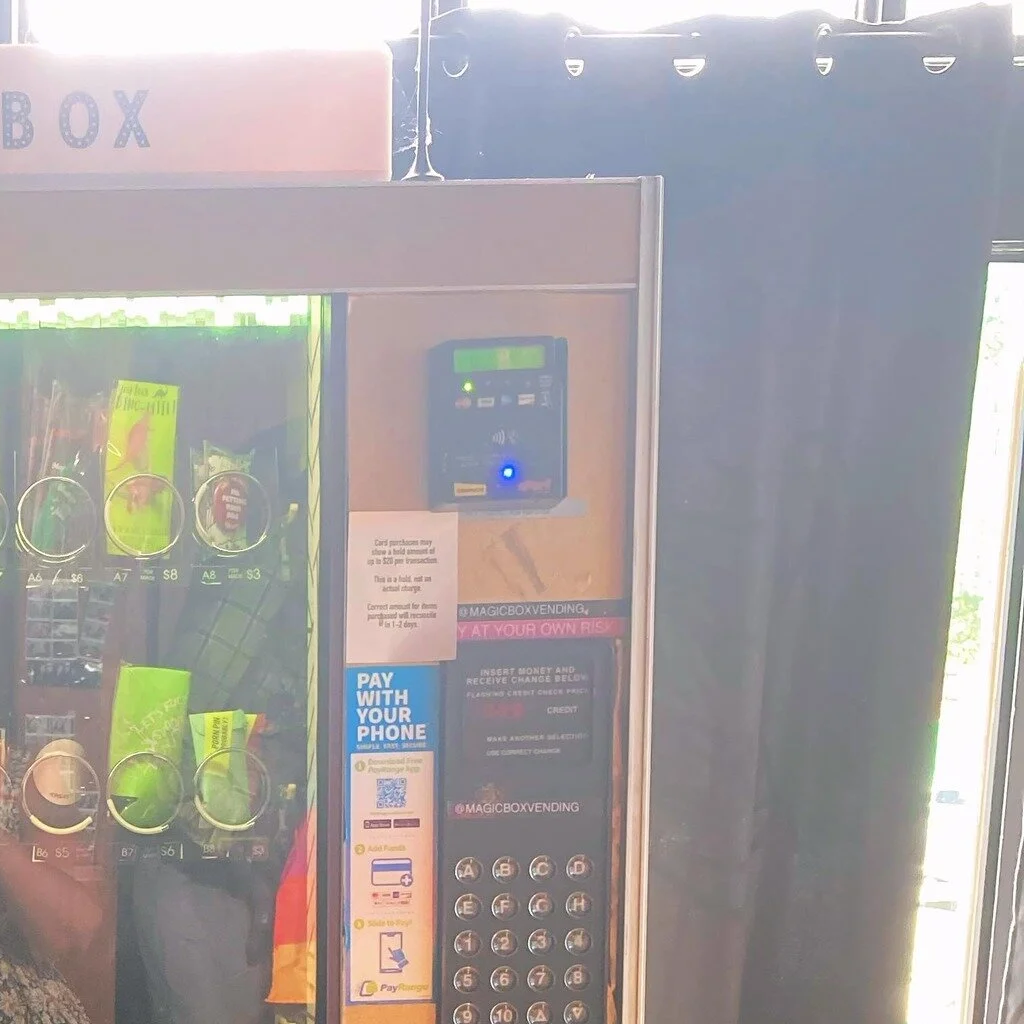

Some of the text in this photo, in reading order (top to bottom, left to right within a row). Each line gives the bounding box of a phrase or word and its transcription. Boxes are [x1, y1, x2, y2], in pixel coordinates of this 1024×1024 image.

[1, 89, 152, 150] BOX
[420, 539, 433, 548] may
[27, 573, 43, 584] A6
[112, 572, 129, 583] A7
[163, 569, 179, 581] $8
[201, 570, 217, 580] A8
[246, 569, 262, 580] $3
[367, 603, 389, 611] Correct
[411, 602, 420, 610] for
[458, 603, 586, 618] @MAGICBOXVENDING
[471, 623, 491, 637] AT
[494, 622, 536, 637] YOUR
[540, 621, 576, 636] OWN
[480, 665, 576, 677] INSERT MONEY AND
[357, 672, 394, 690] PAY
[466, 676, 508, 686] RECEIVE
[511, 675, 551, 684] CHANGE
[356, 688, 409, 707] WITH
[507, 688, 564, 697] CREDIT CHECK
[356, 706, 412, 725] YOUR
[546, 705, 580, 714] CREDIT
[357, 723, 427, 742] PHONE
[454, 801, 580, 815] @MAGICBOXVENDING
[36, 847, 49, 858] B6
[121, 847, 176, 858] B7 $6
[367, 844, 383, 852] Add
[463, 862, 586, 877] A B C D
[463, 898, 585, 915] E F G H
[464, 938, 472, 950] 1
[499, 938, 510, 950] 2
[536, 936, 547, 949] 3
[462, 971, 583, 987] 5 6 7 8
[379, 981, 429, 993] PayRange
[462, 1010, 513, 1024] 9 10
